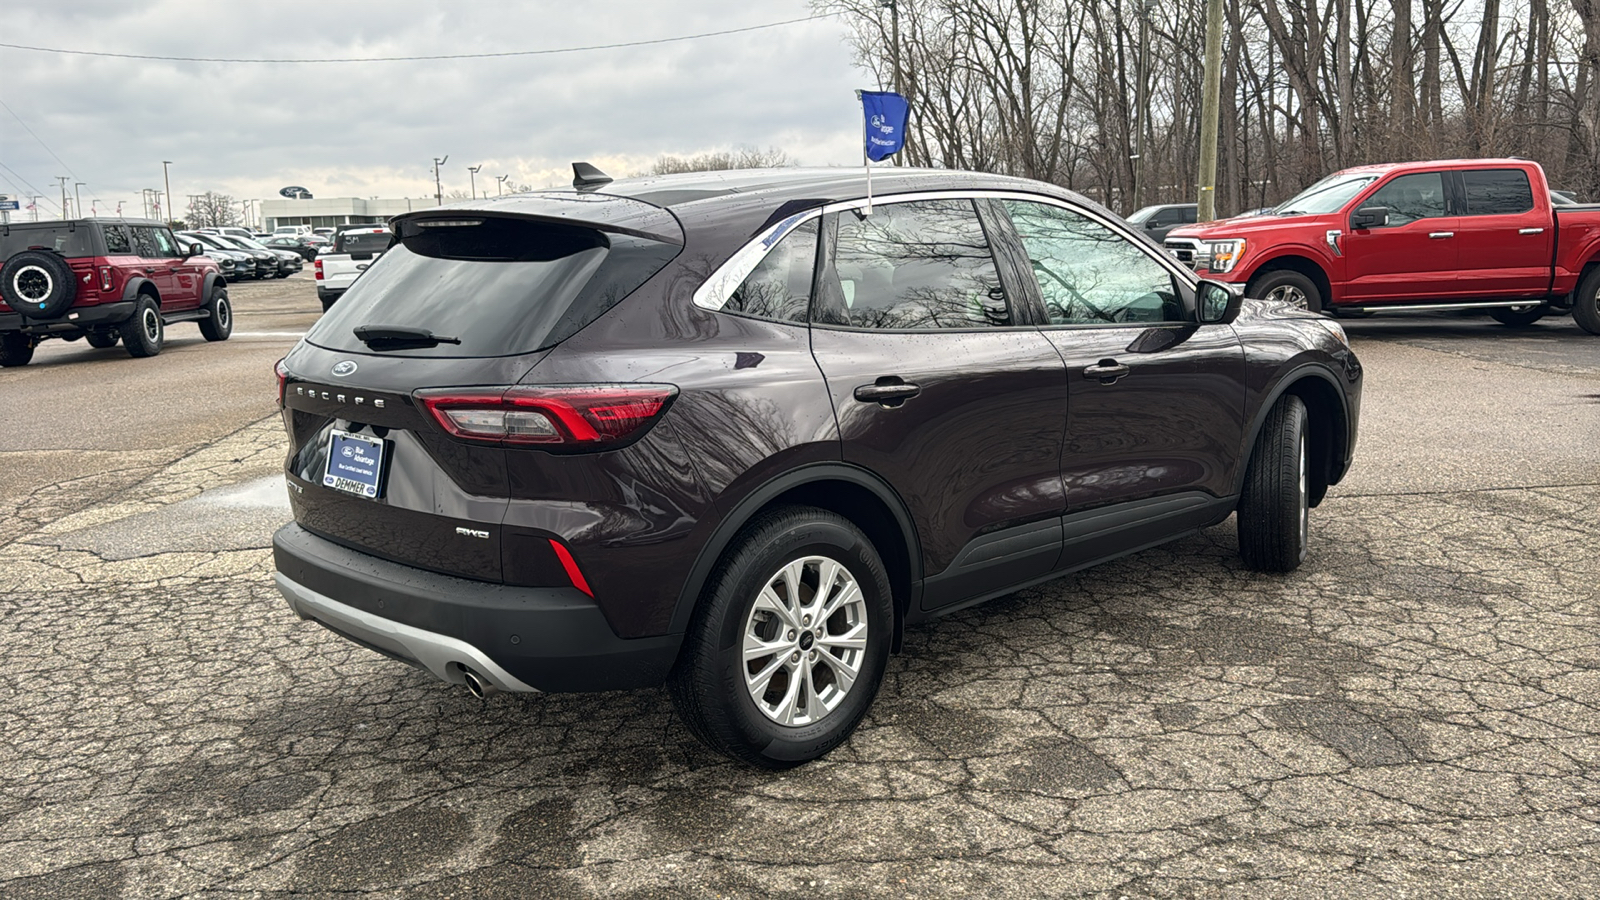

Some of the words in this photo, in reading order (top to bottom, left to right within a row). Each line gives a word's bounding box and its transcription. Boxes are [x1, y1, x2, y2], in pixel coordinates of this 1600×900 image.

[297, 387, 385, 408] ESCAPE
[355, 445, 365, 455] Blue
[353, 454, 375, 466] Advantage
[335, 477, 366, 494] DEMMER
[455, 526, 490, 539] AWD
